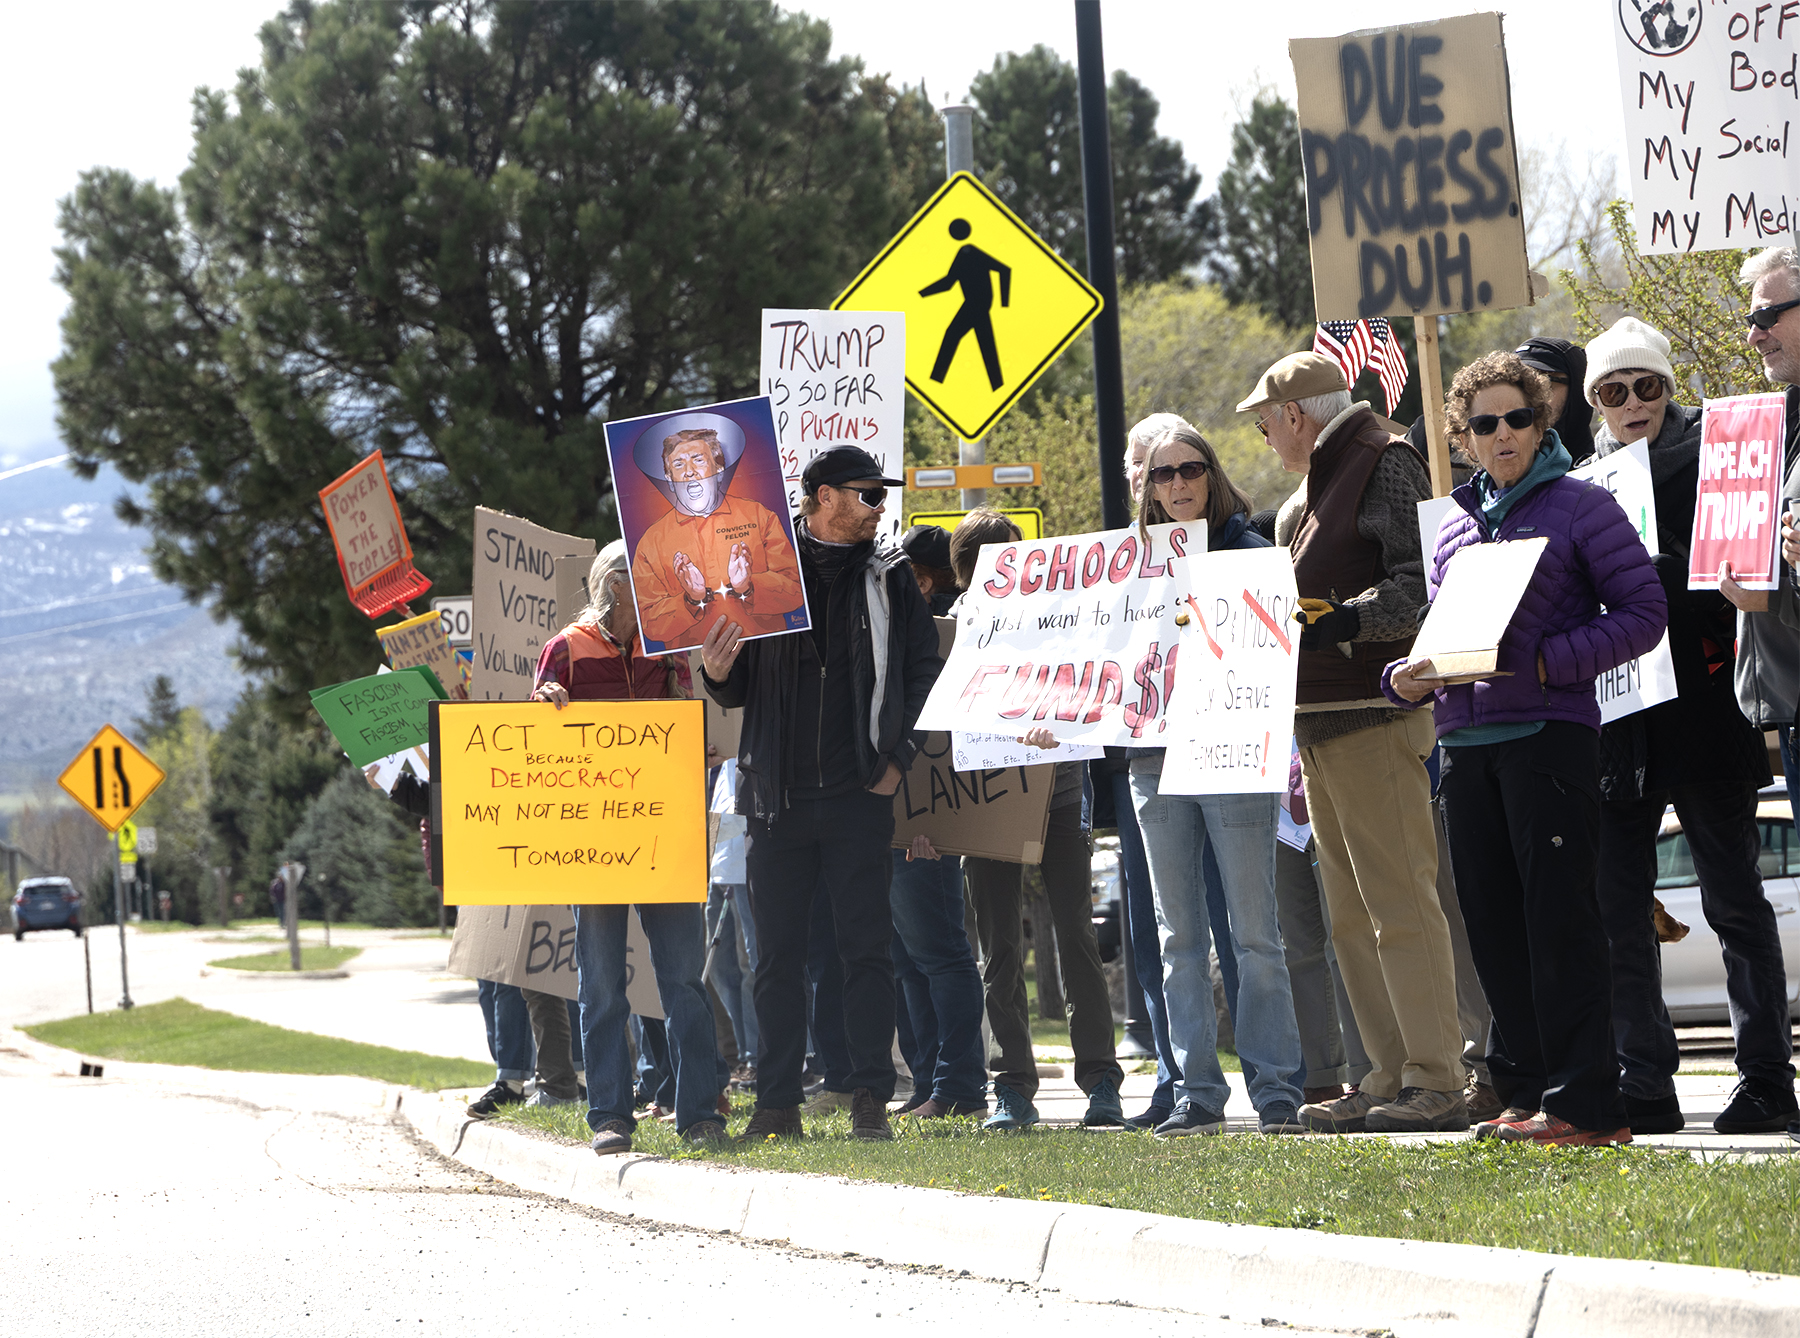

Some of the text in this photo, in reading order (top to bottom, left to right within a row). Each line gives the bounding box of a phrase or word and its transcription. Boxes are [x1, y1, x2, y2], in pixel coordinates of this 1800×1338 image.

[1728, 0, 1800, 43] OFF
[1341, 33, 1444, 131] DUE
[1639, 70, 1695, 135] My
[1644, 118, 1790, 200] My Social
[1302, 127, 1519, 238] PROCESS.
[1651, 209, 1700, 252] My
[1358, 231, 1492, 317] DUH.
[770, 320, 885, 373] TRUMP
[769, 374, 884, 407] IS SO FAR
[801, 410, 879, 442] PUTIN'S
[1700, 439, 1772, 481] IMPEACH
[329, 472, 378, 522] POWER
[1699, 490, 1769, 541] TRUMP
[350, 510, 367, 528] TO
[716, 523, 757, 534] CONVICTED
[725, 531, 749, 540] FELON
[349, 523, 378, 554] THE
[485, 528, 554, 581] STAND
[983, 527, 1188, 598] SCHOOLS
[499, 579, 558, 631] VOTER
[1038, 605, 1080, 630] want
[1092, 601, 1110, 626] to
[1123, 595, 1166, 623] have
[386, 622, 442, 656] UNITE
[339, 682, 409, 715] FASCISM
[1225, 670, 1271, 709] SERVE
[360, 717, 410, 745] FASCISM
[464, 722, 675, 754] ACT TODAY
[526, 753, 594, 765] BECAUSE
[1004, 755, 1020, 764] Etc.
[491, 767, 641, 790] DEMOCRACY
[465, 800, 664, 826] MAY NOT BE HERE
